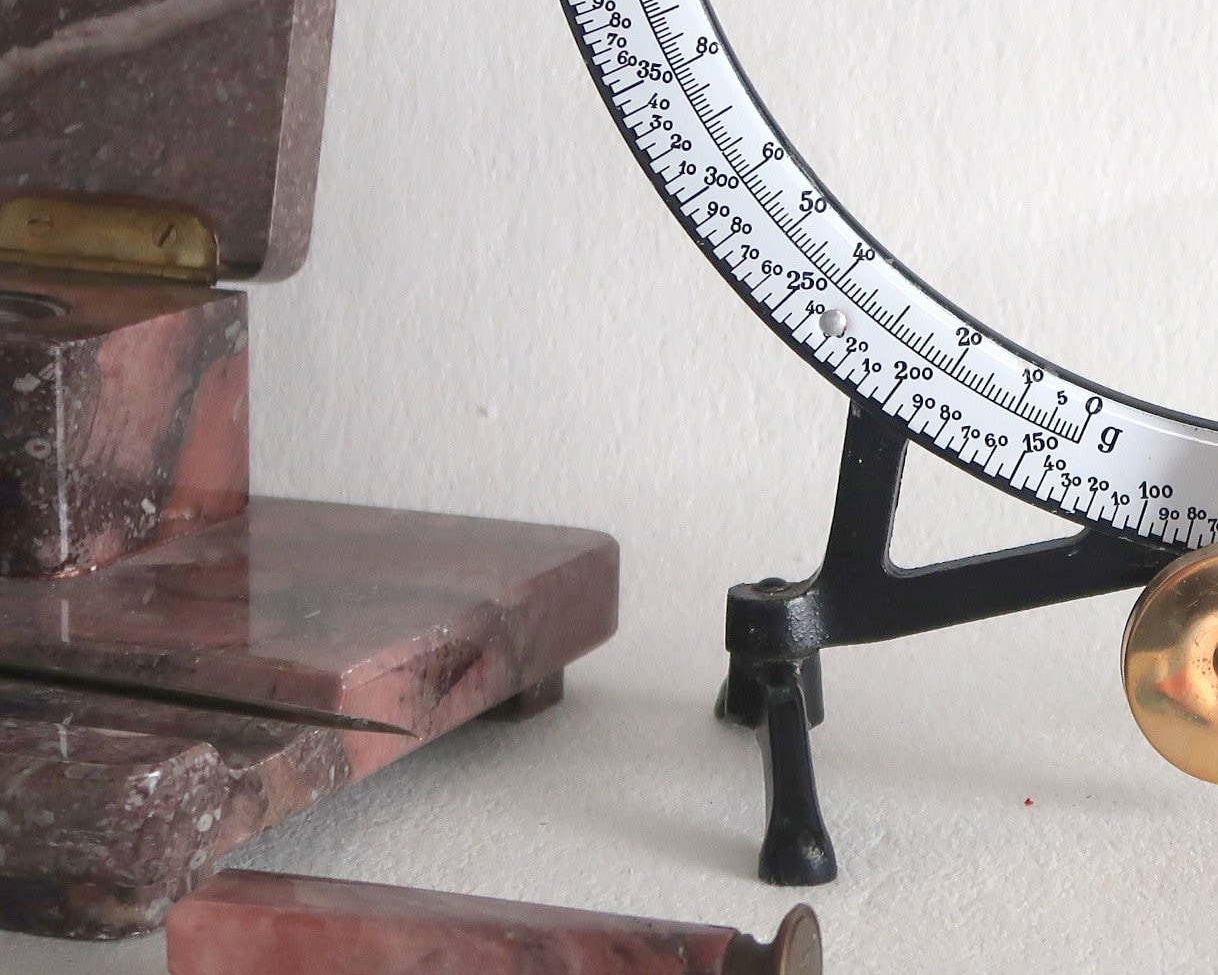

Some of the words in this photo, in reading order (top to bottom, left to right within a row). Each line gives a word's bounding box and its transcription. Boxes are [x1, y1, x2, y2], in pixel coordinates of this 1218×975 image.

[609, 12, 632, 29] 80
[606, 32, 627, 48] 70
[695, 36, 719, 54] 80
[617, 50, 637, 66] 60
[636, 60, 673, 84] 350
[649, 93, 670, 109] 40
[650, 114, 673, 131] 30
[670, 133, 692, 151] 20
[762, 141, 785, 161] 60
[678, 160, 697, 176] 10
[703, 166, 739, 189] 300
[707, 201, 730, 218] 90
[799, 190, 827, 214] 50
[730, 216, 752, 234] 80
[740, 245, 760, 260] 70
[852, 242, 876, 261] 40
[761, 260, 783, 276] 60
[786, 271, 828, 291] 250
[805, 300, 826, 315] 40
[845, 336, 869, 353] 20
[955, 326, 983, 347] 20
[861, 358, 882, 374] 10
[893, 360, 934, 381] 200
[1022, 368, 1044, 384] 10
[912, 393, 936, 410] 90
[1056, 390, 1068, 406] 5
[939, 404, 962, 421] 80
[961, 425, 981, 440] 70
[984, 433, 1008, 448] 60
[1097, 426, 1124, 454] g
[1022, 432, 1059, 454] 150
[1043, 454, 1067, 472] 40
[1060, 472, 1082, 488] 30
[1087, 476, 1109, 492] 20
[1110, 491, 1130, 506] 10
[1138, 481, 1173, 500] 100
[1158, 507, 1180, 521] 90
[1187, 506, 1207, 520] 80
